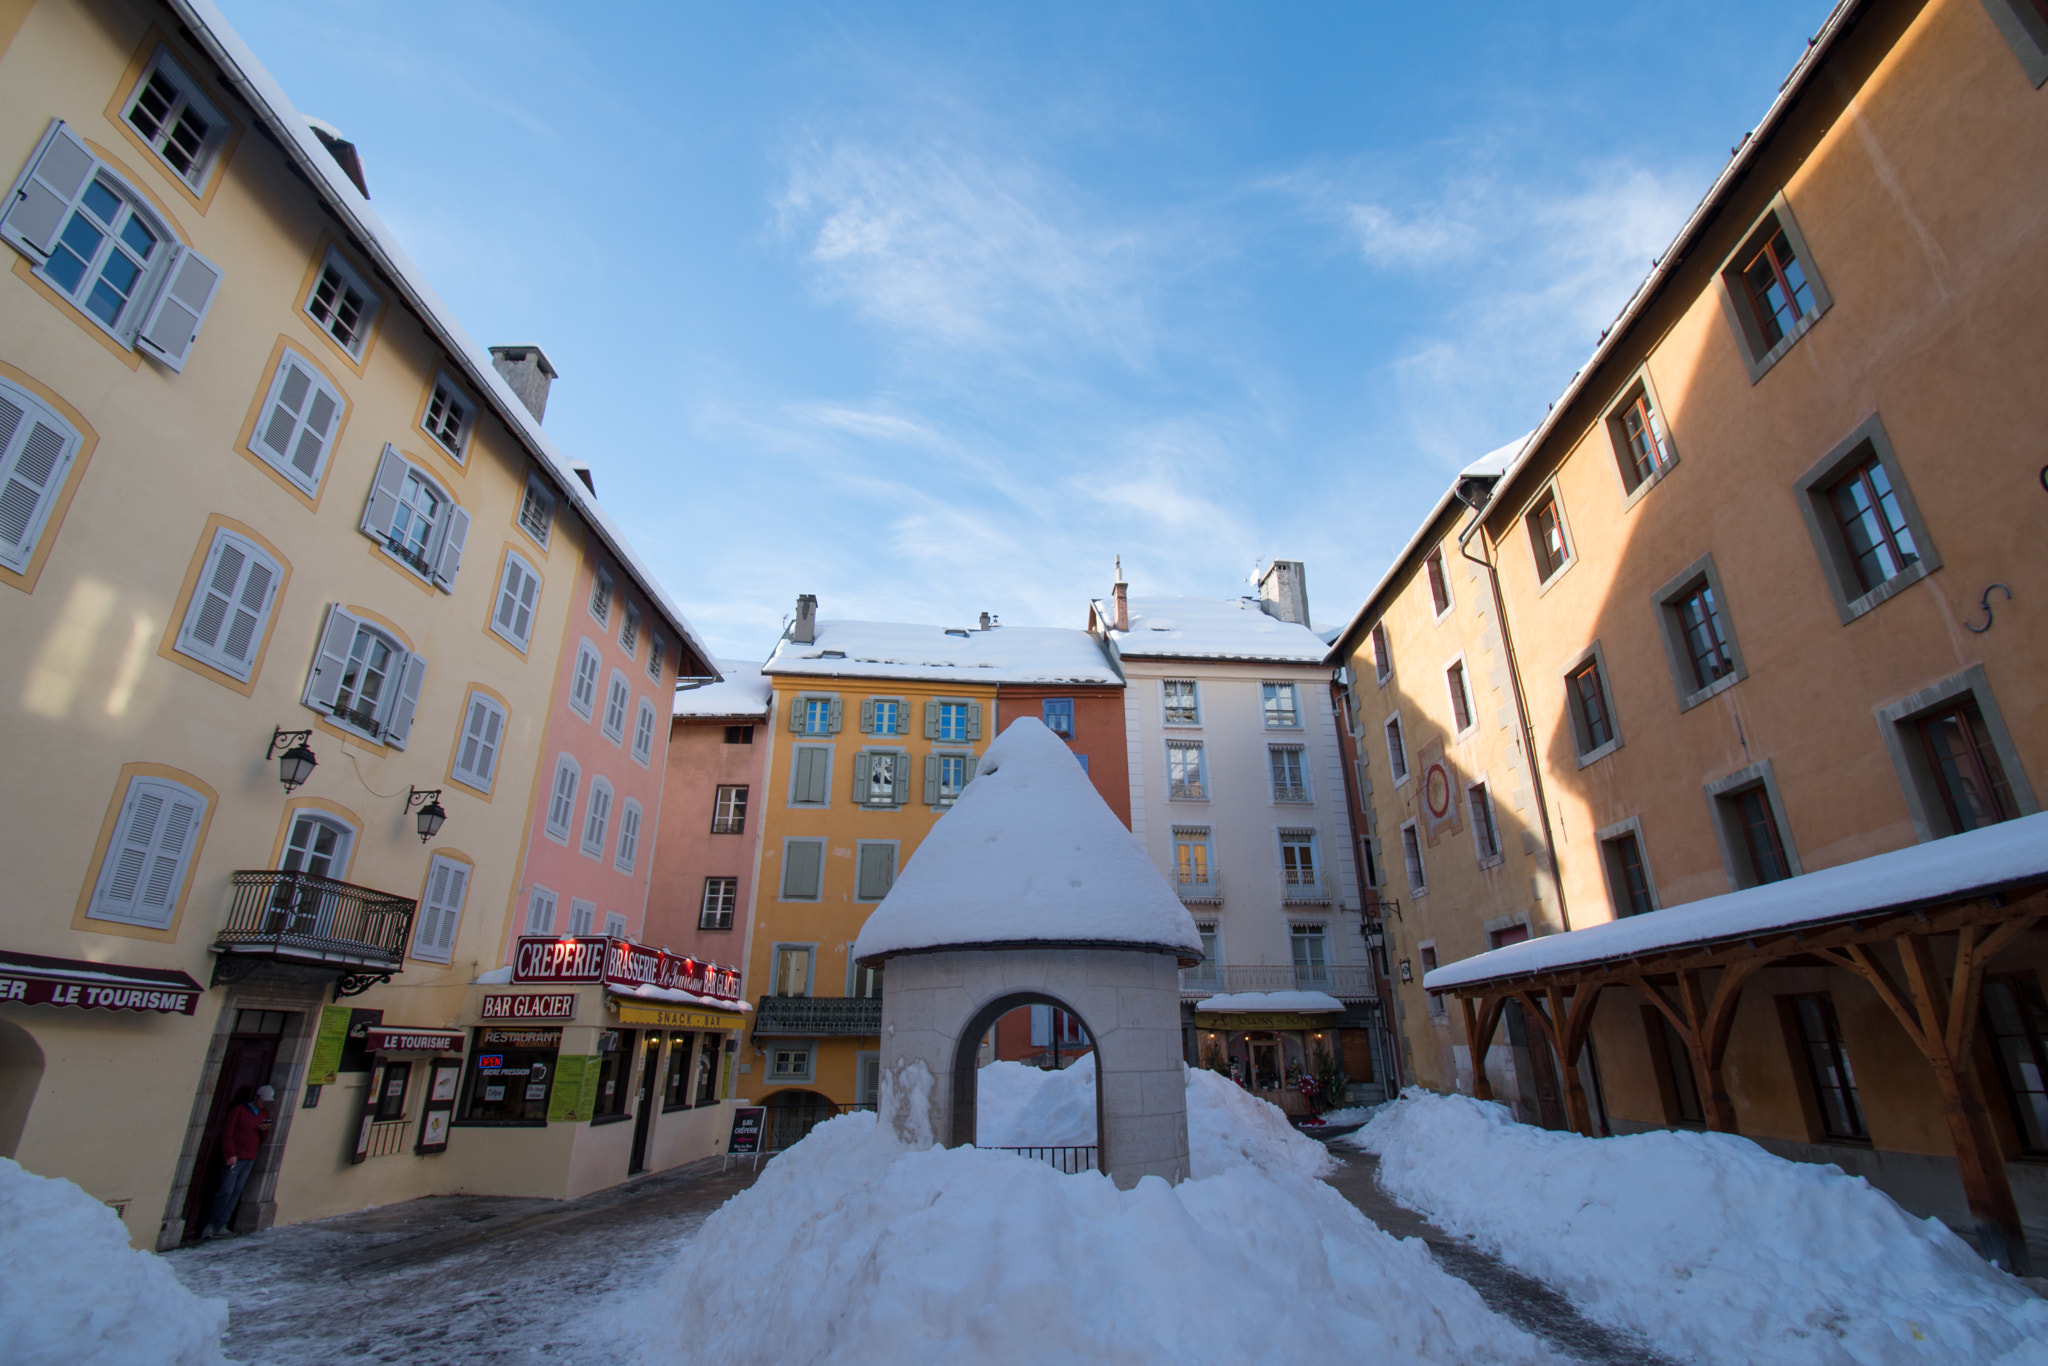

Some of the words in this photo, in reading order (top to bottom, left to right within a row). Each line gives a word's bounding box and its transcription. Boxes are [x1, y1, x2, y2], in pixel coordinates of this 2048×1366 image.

[517, 943, 604, 977] CREPERIE
[607, 947, 658, 983] BRASSERIE
[658, 958, 670, 984] Le
[668, 961, 703, 992] Tourisme
[703, 971, 716, 994] BAR
[716, 973, 741, 999] GLACIER
[51, 985, 82, 1003] LE
[86, 987, 188, 1011] TOURISME
[484, 996, 511, 1017] BAR
[514, 995, 572, 1016] GLACIER
[657, 1012, 692, 1024] SNACK
[704, 1016, 721, 1026] BAR
[383, 1035, 397, 1048] LE
[400, 1036, 451, 1049] TOURISME
[485, 1031, 561, 1042] RESTAURANT
[480, 1057, 501, 1067] OPEN
